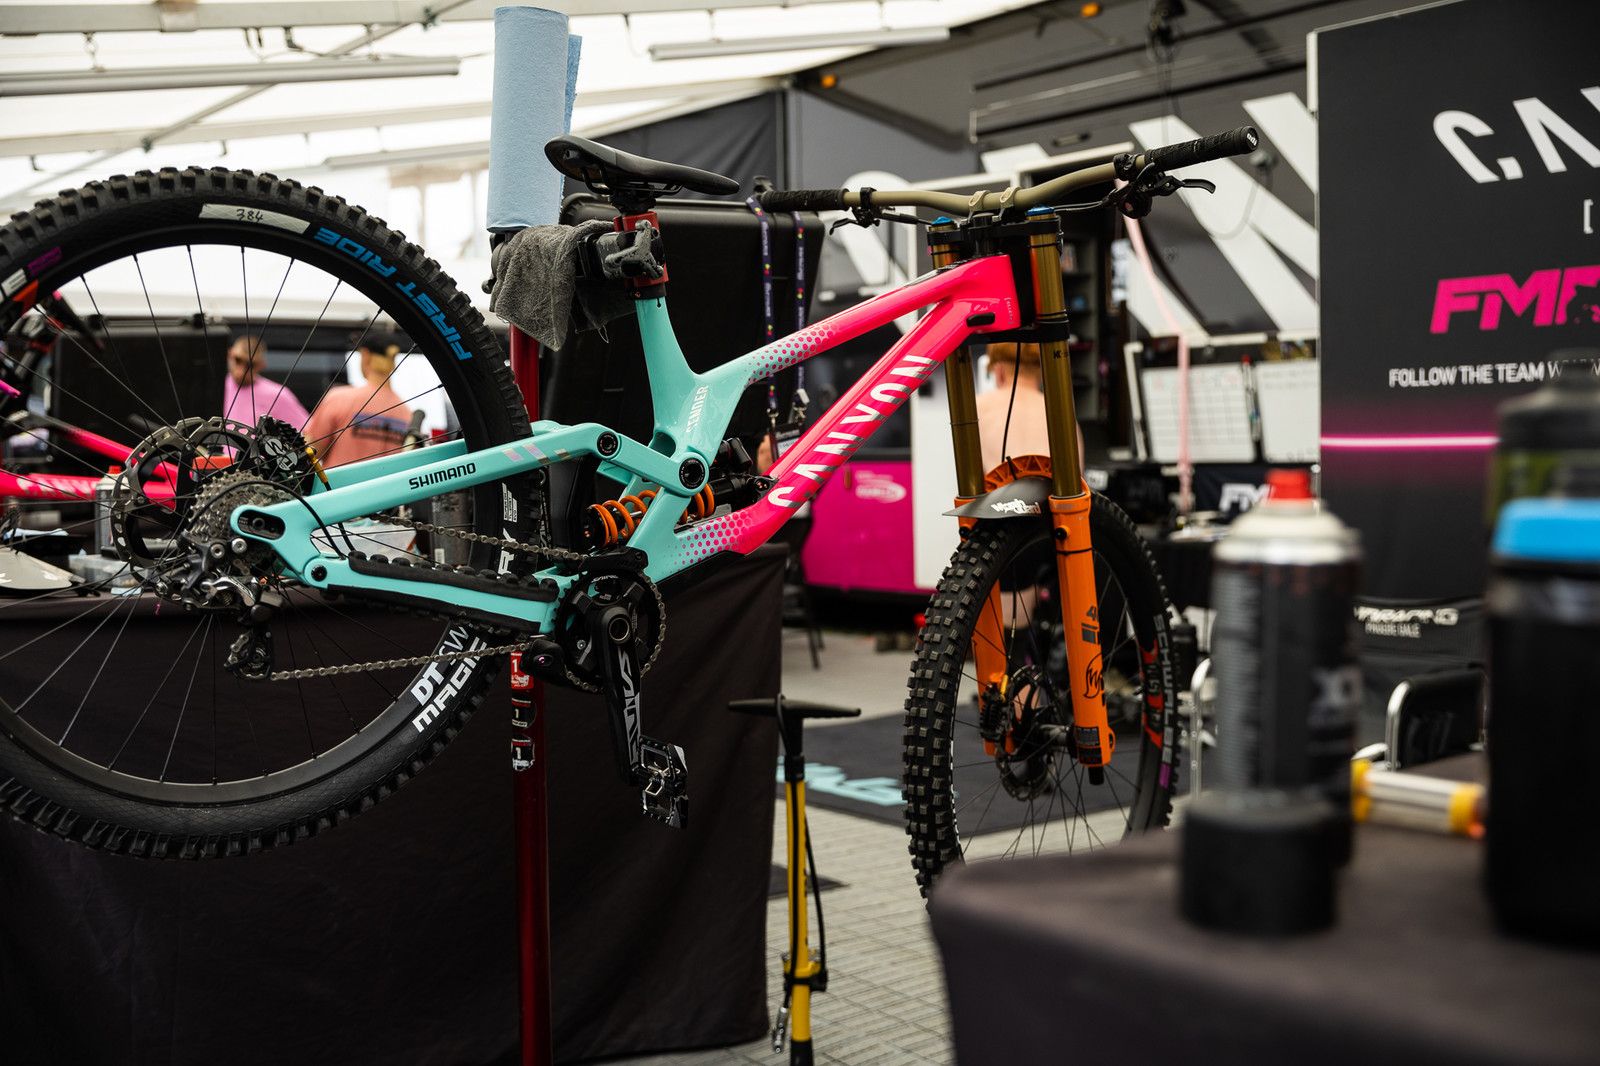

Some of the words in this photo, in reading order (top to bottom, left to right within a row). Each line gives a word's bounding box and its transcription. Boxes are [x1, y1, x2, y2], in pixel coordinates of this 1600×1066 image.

[236, 208, 264, 223] 384
[313, 227, 397, 278] RIDE
[395, 281, 473, 361] FIRST
[1389, 366, 1457, 388] FOLLOW
[1459, 364, 1494, 385] THE
[1495, 361, 1545, 384] TEAM
[686, 384, 709, 433] SENDER
[768, 355, 939, 508] CANYON
[408, 462, 476, 490] SHIMANO
[410, 661, 445, 707] DT
[1153, 614, 1174, 764] SCHWALBE
